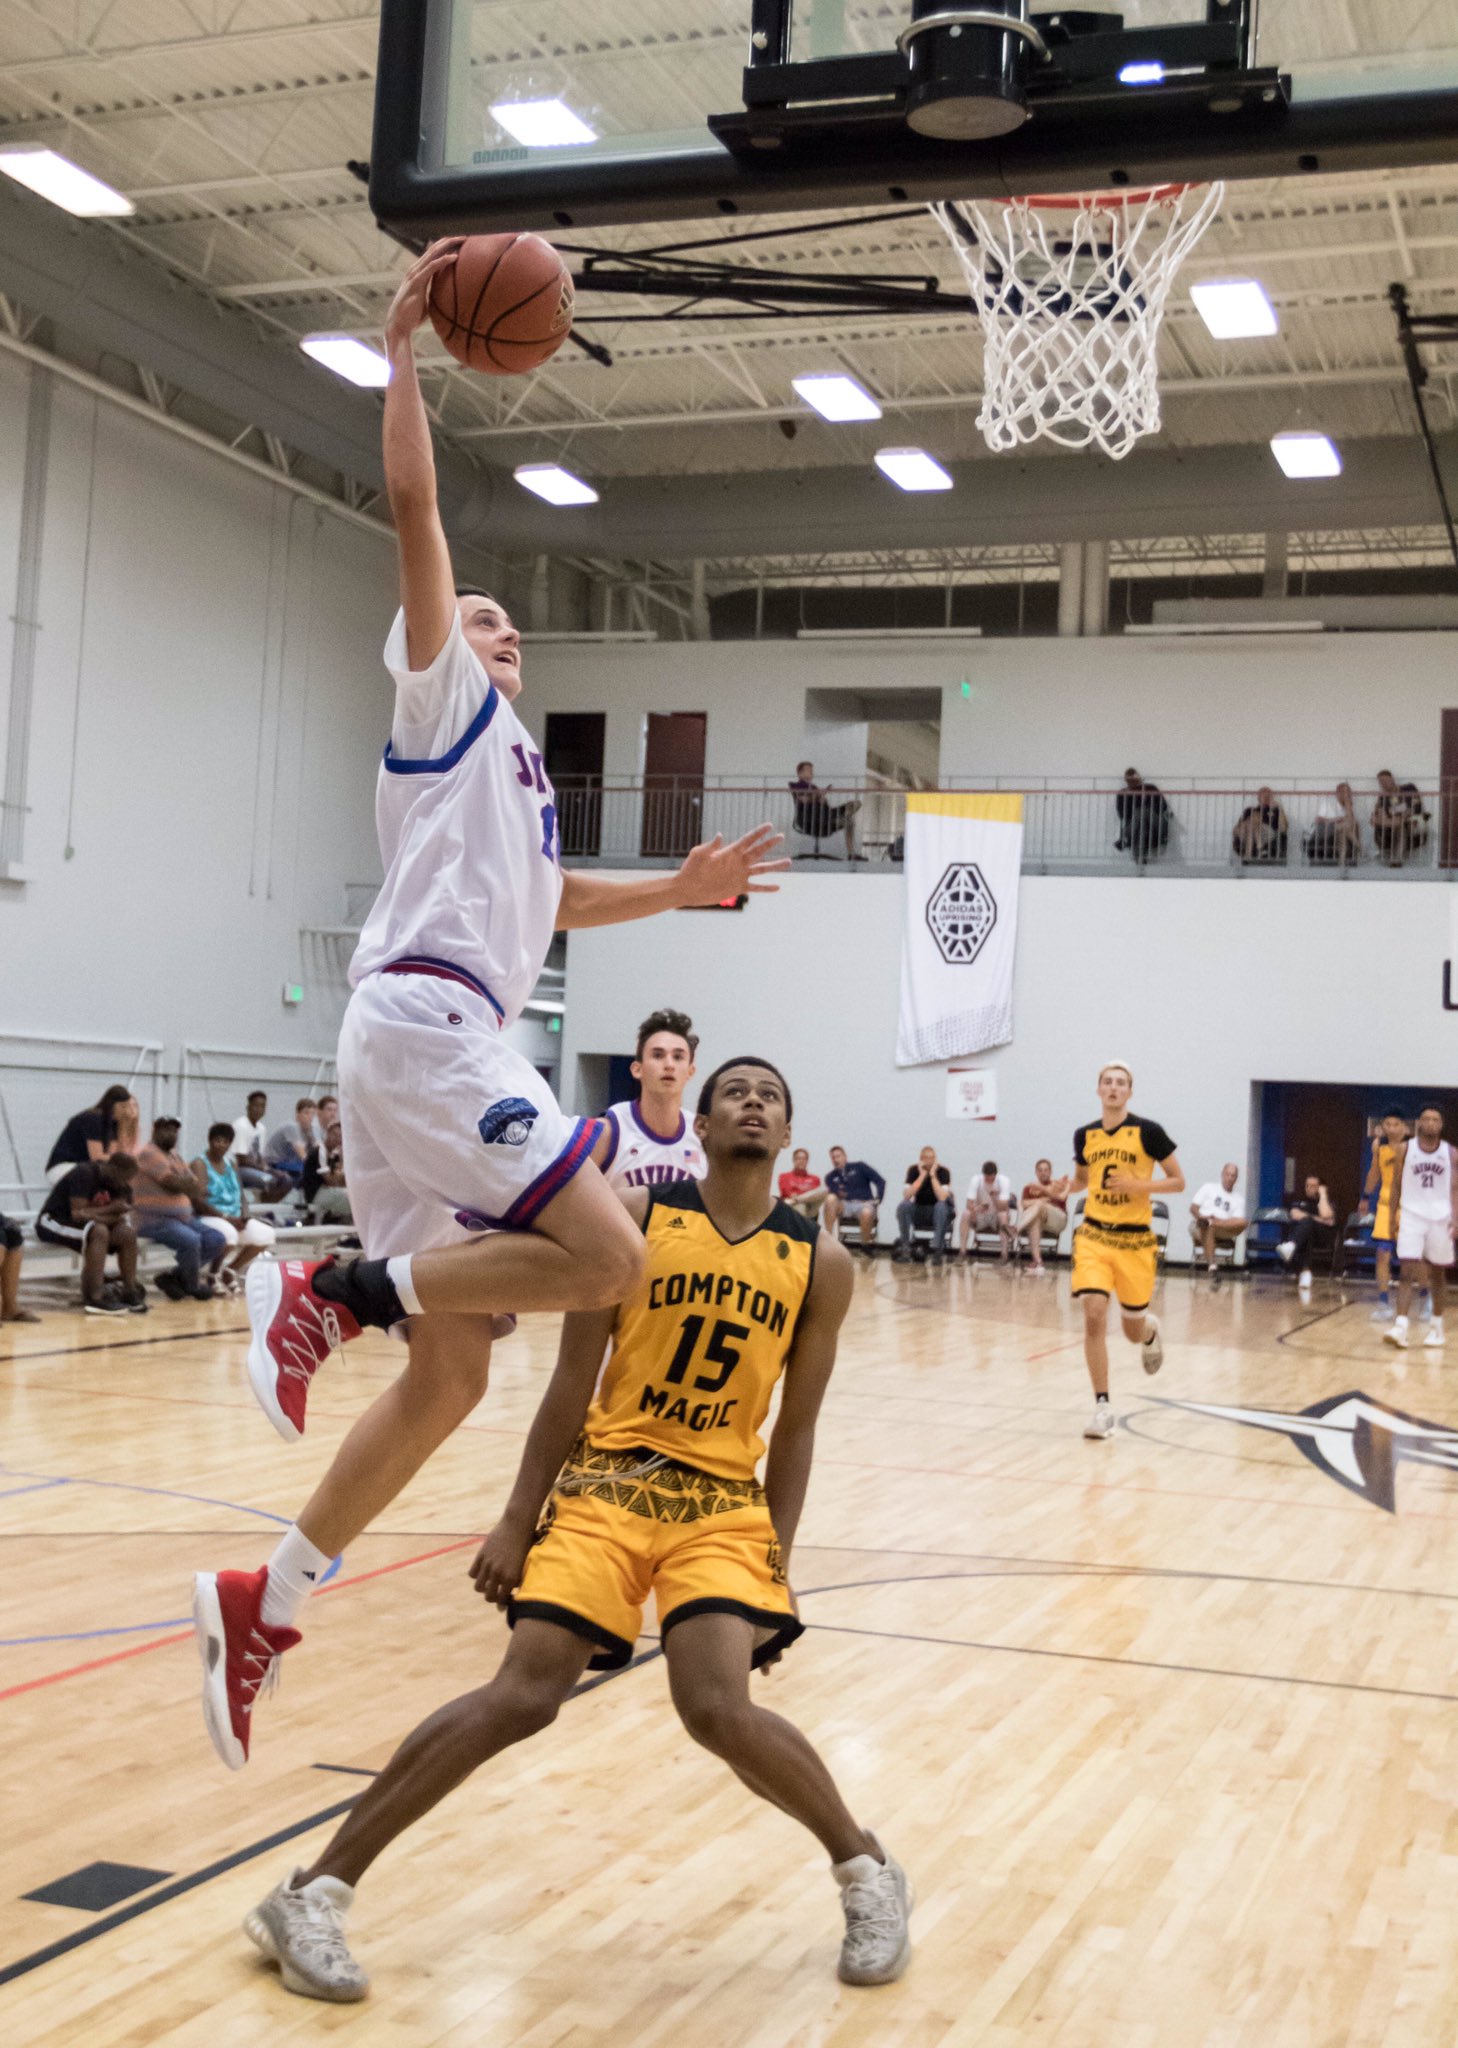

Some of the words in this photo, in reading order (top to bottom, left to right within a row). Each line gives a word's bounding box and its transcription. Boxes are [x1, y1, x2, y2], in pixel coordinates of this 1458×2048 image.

[940, 904, 983, 913] ADIDAS
[1421, 1173, 1434, 1188] 21
[648, 1272, 789, 1338] COMPTON
[664, 1313, 751, 1393] 15
[638, 1384, 738, 1432] MAGIC
